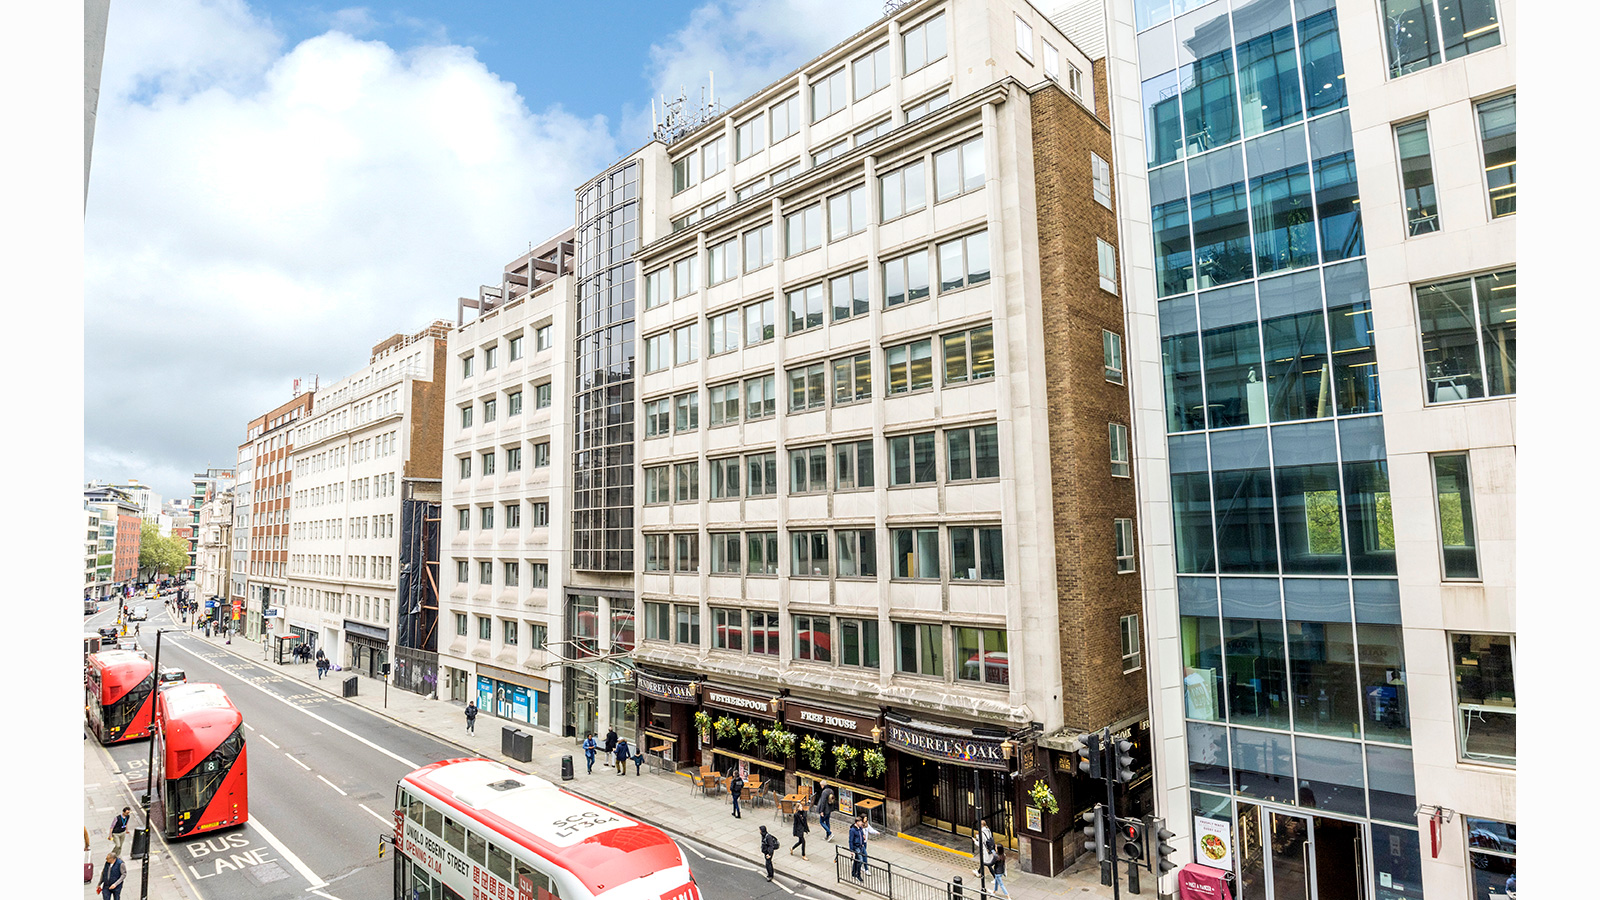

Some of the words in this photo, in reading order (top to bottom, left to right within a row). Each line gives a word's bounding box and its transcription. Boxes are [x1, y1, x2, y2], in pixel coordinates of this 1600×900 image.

[673, 686, 693, 697] OAK
[709, 692, 768, 712] WETHERSPOON
[801, 711, 824, 724] FREE
[824, 715, 857, 730] HOUSE
[892, 727, 962, 754] PENDEREL'S
[965, 743, 999, 759] OAK
[208, 761, 215, 771] 8
[553, 811, 600, 827] SCG
[186, 833, 250, 858] BUS
[406, 823, 424, 846] UNIQLO
[424, 833, 446, 861] REGENT
[447, 851, 470, 878] STREET
[188, 846, 278, 880] LANE
[405, 839, 427, 864] OPENING
[427, 855, 442, 876] 21.04
